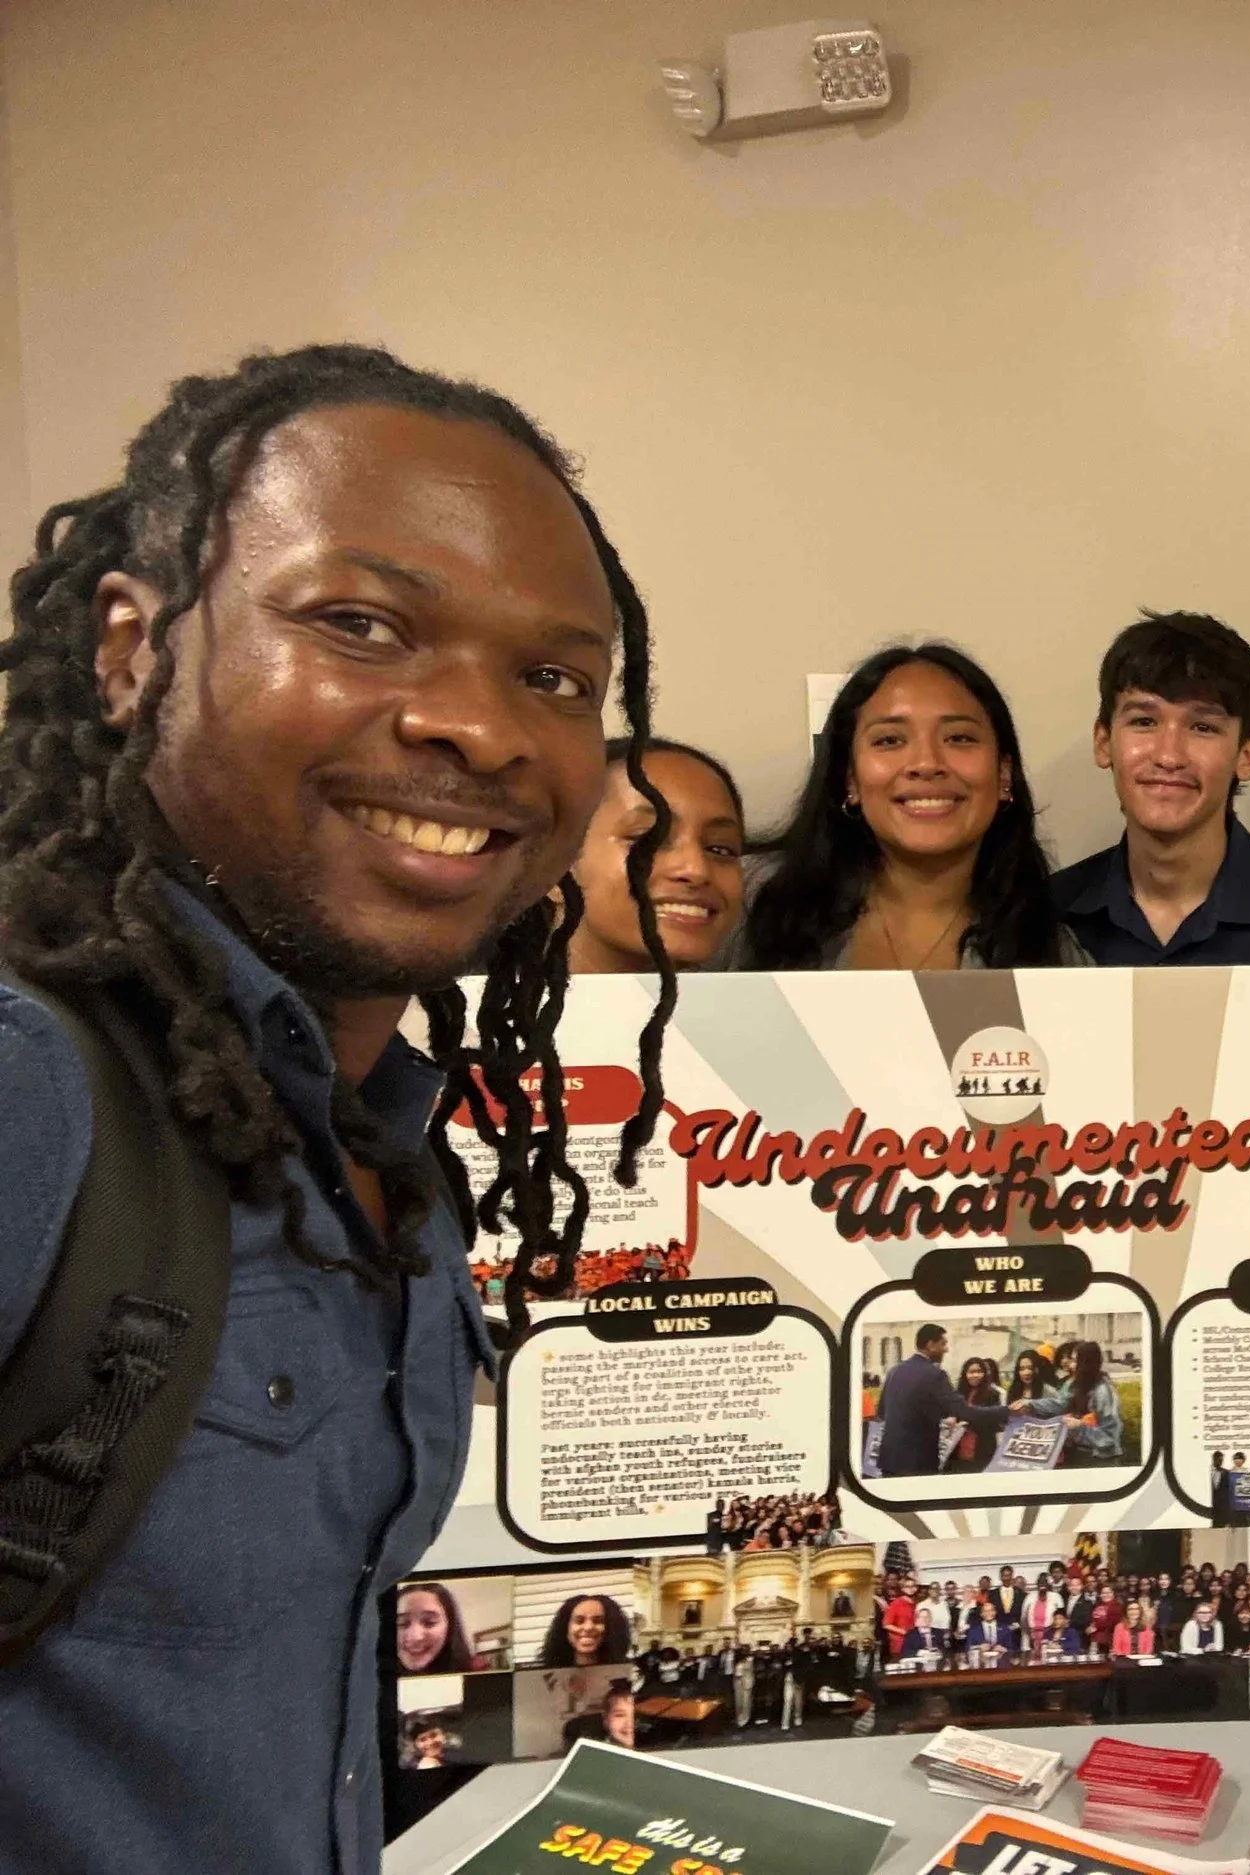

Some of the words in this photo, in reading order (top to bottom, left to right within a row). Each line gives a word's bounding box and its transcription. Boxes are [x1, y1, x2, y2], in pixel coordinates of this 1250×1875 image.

[811, 1156, 1190, 1242] Unafraid
[975, 1256, 1024, 1271] WHO
[964, 1280, 997, 1294] WE
[1004, 1278, 1044, 1293] ARE
[588, 1296, 657, 1313] LOCAL
[665, 1290, 774, 1309] CAMPAIGN
[653, 1316, 711, 1333] WINS
[560, 1353, 594, 1362] some
[600, 1348, 666, 1361] highlights
[670, 1345, 696, 1357] this
[700, 1346, 729, 1356] year
[732, 1341, 785, 1352] include:
[541, 1363, 592, 1375] passing
[597, 1361, 618, 1371] the
[623, 1357, 685, 1370] maryland
[690, 1355, 731, 1365] access
[753, 1353, 779, 1362] care
[541, 1375, 579, 1387] being
[583, 1373, 610, 1384] part
[644, 1367, 703, 1380] coalition
[757, 1363, 794, 1375] youth
[541, 1397, 584, 1409] taking
[589, 1394, 631, 1405] action
[676, 1388, 729, 1401] meeting
[733, 1386, 781, 1397] senator
[575, 1383, 628, 1396] fighting
[634, 1381, 652, 1391] for
[656, 1378, 725, 1390] immigrant
[541, 1408, 585, 1419] bernie
[589, 1405, 640, 1416] sanders
[646, 1402, 669, 1413] and
[672, 1400, 707, 1411] other
[712, 1397, 759, 1409] elected
[541, 1418, 597, 1430] officials
[601, 1416, 631, 1427] both
[635, 1412, 701, 1426] nationally
[541, 1444, 569, 1453] Past
[575, 1441, 614, 1453] years:
[619, 1436, 699, 1450] successfully
[703, 1433, 748, 1443] having
[541, 1465, 571, 1476] with
[625, 1460, 664, 1471] youth
[732, 1451, 806, 1464] fundraisers
[538, 1824, 655, 1875] SAFE
[636, 1818, 695, 1849] this
[690, 1836, 724, 1857] is
[718, 1847, 746, 1863] a
